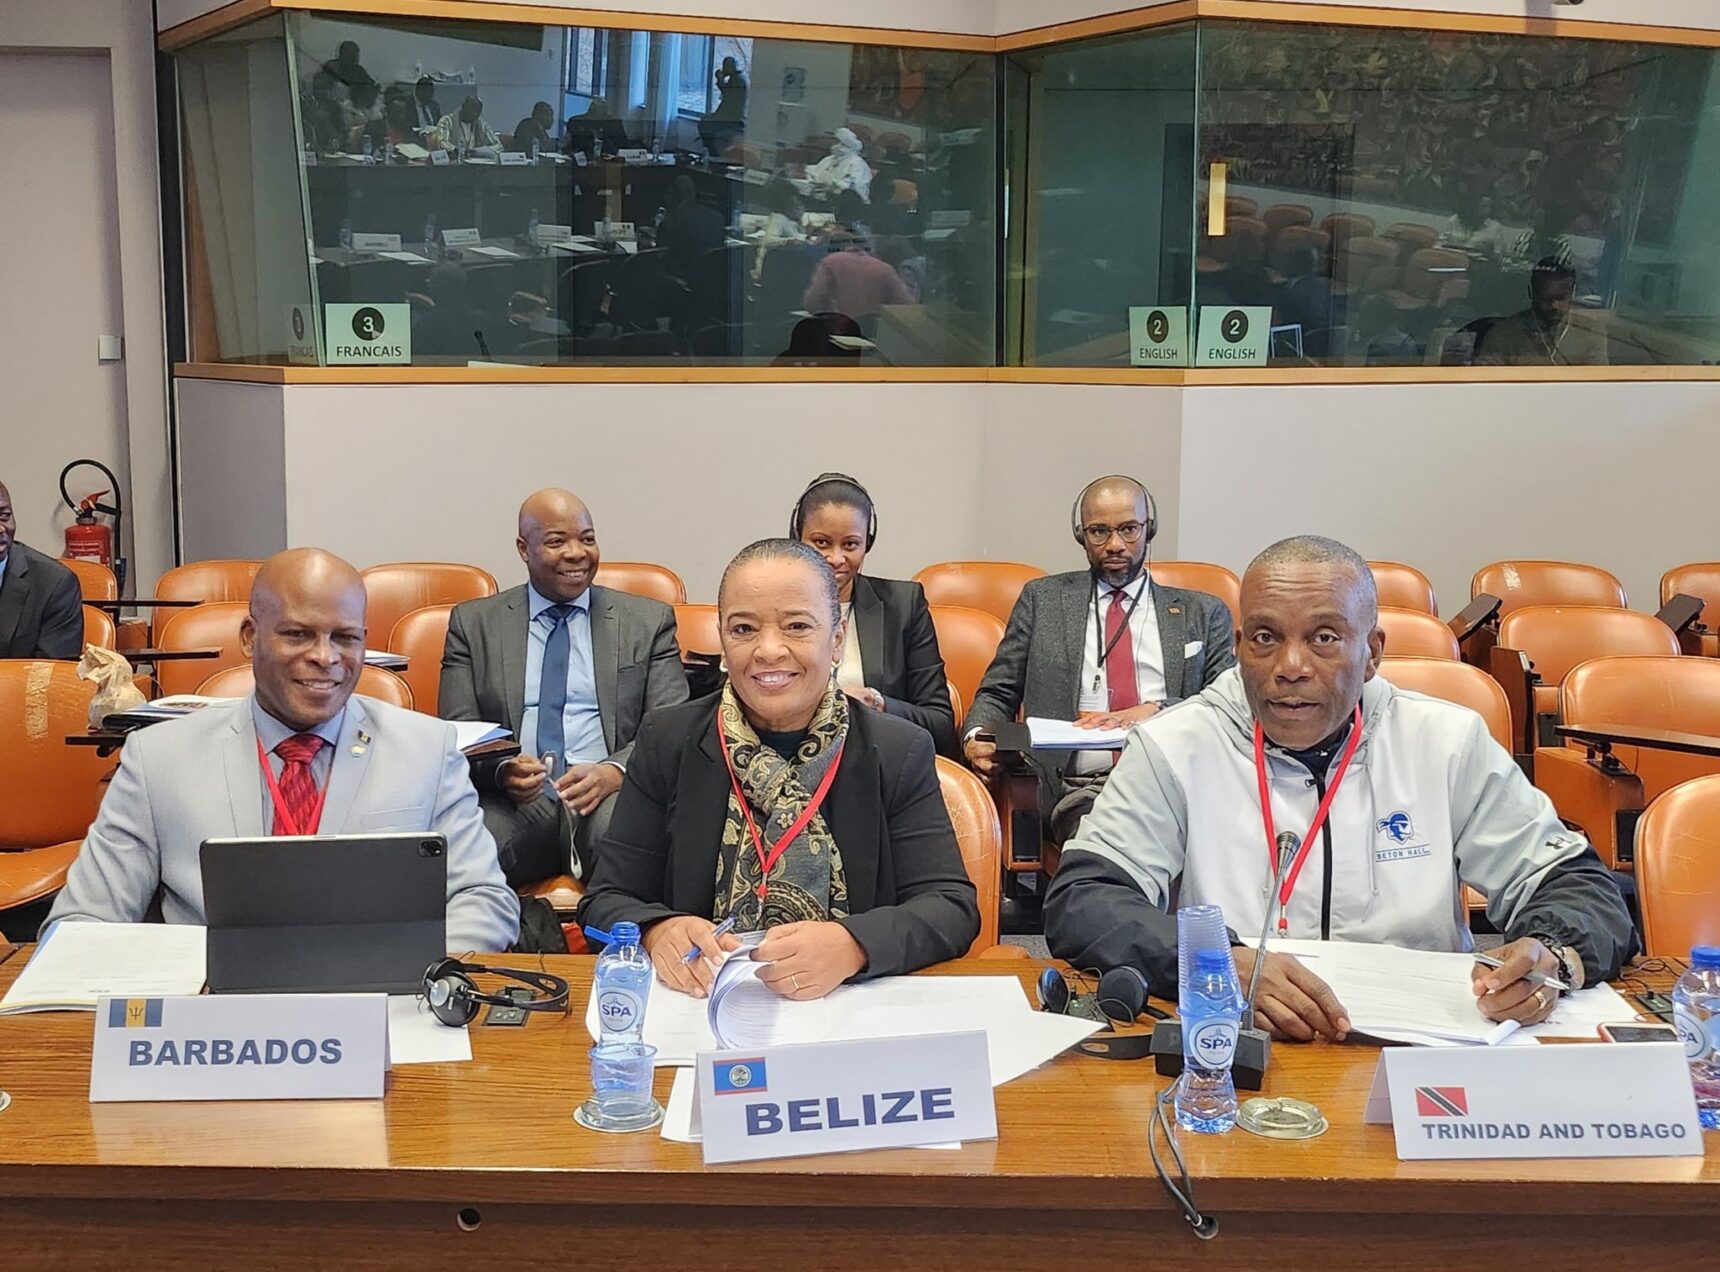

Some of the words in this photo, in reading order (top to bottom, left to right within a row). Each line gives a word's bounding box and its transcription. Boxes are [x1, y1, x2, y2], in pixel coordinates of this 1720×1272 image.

[362, 316, 374, 333] 3
[1153, 319, 1162, 335] 2
[1229, 319, 1240, 335] 2
[336, 345, 402, 358] FRANCAIS
[1139, 347, 1178, 359] ENGLISH
[1208, 348, 1256, 360] ENGLISH
[1408, 847, 1426, 856] HALL
[601, 1004, 632, 1017] SPA
[1200, 1037, 1232, 1049] SPA
[129, 1038, 343, 1067] BARBADOS
[745, 1087, 955, 1137] BELIZE
[1421, 1123, 1531, 1140] TRINIDAD
[1538, 1123, 1585, 1139] AND
[1590, 1123, 1687, 1139] TOBAGO
